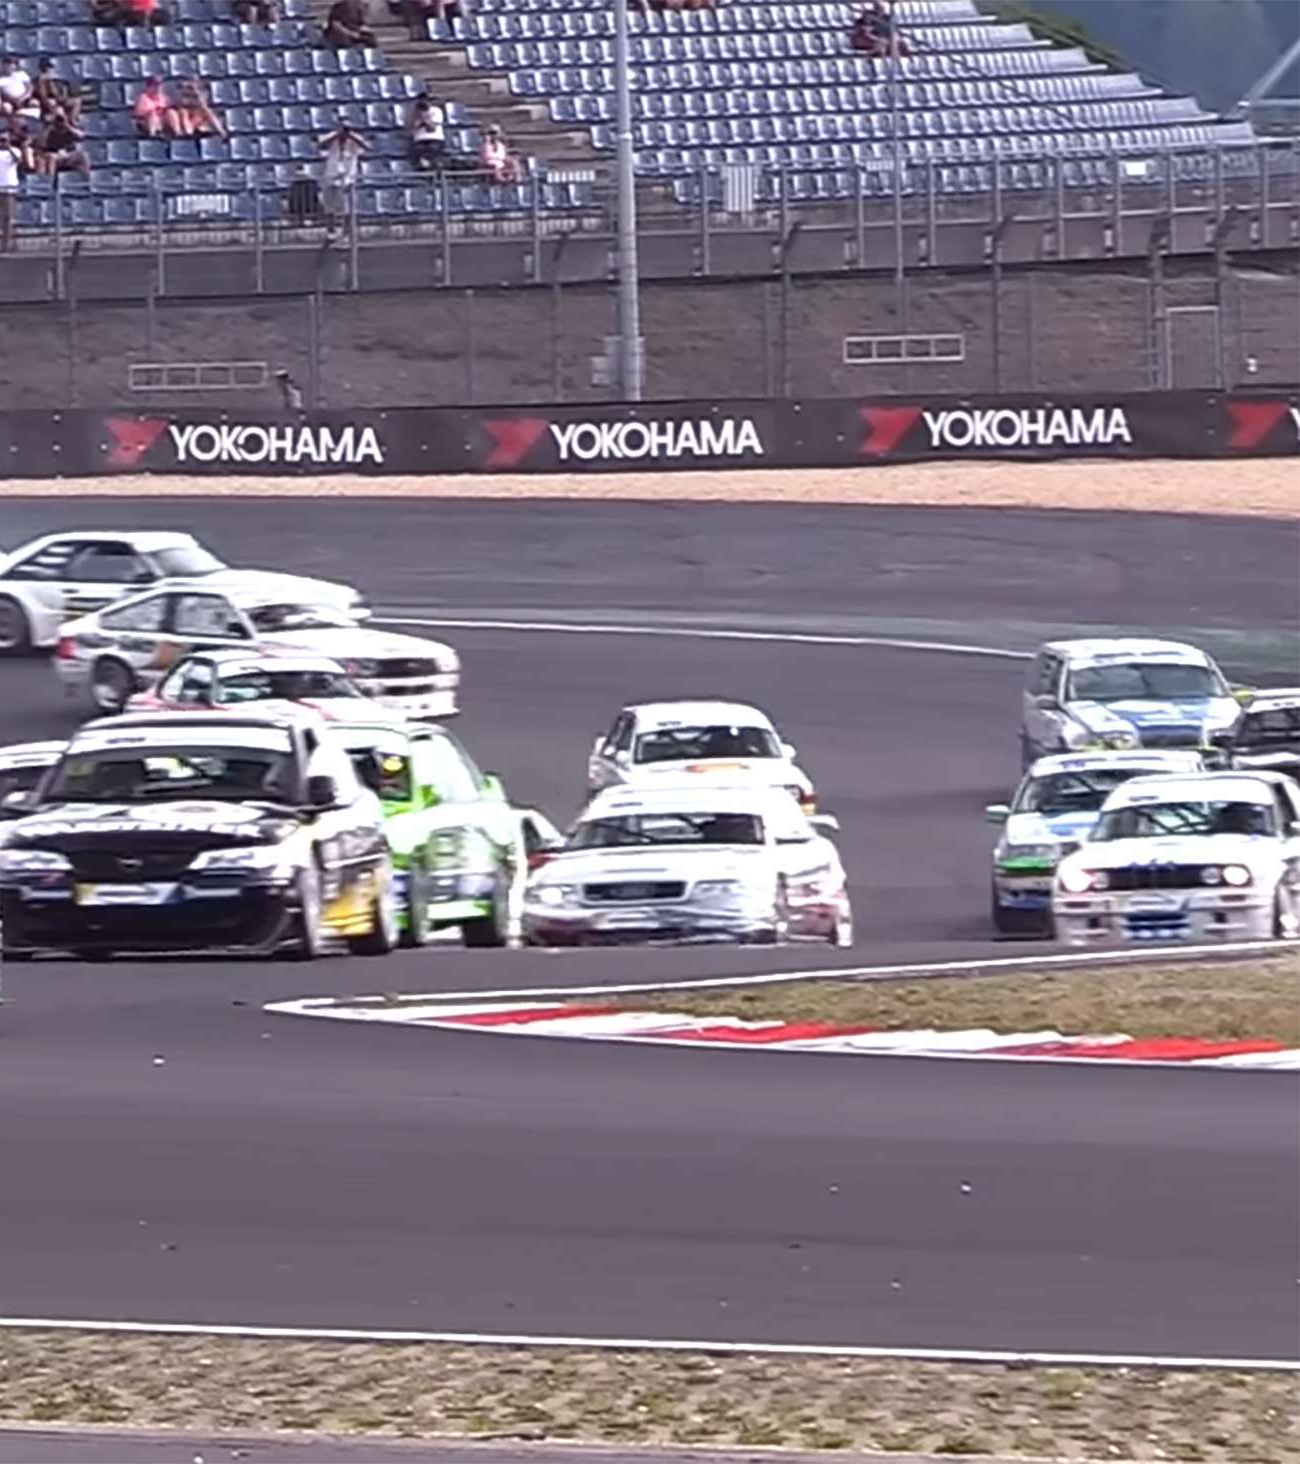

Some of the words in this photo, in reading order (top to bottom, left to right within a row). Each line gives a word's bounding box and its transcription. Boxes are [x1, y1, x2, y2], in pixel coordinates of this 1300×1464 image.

[170, 426, 384, 463] YOKOHAMA
[550, 420, 764, 458] YOKOHAMA
[923, 408, 1132, 447] YOKOHAMA
